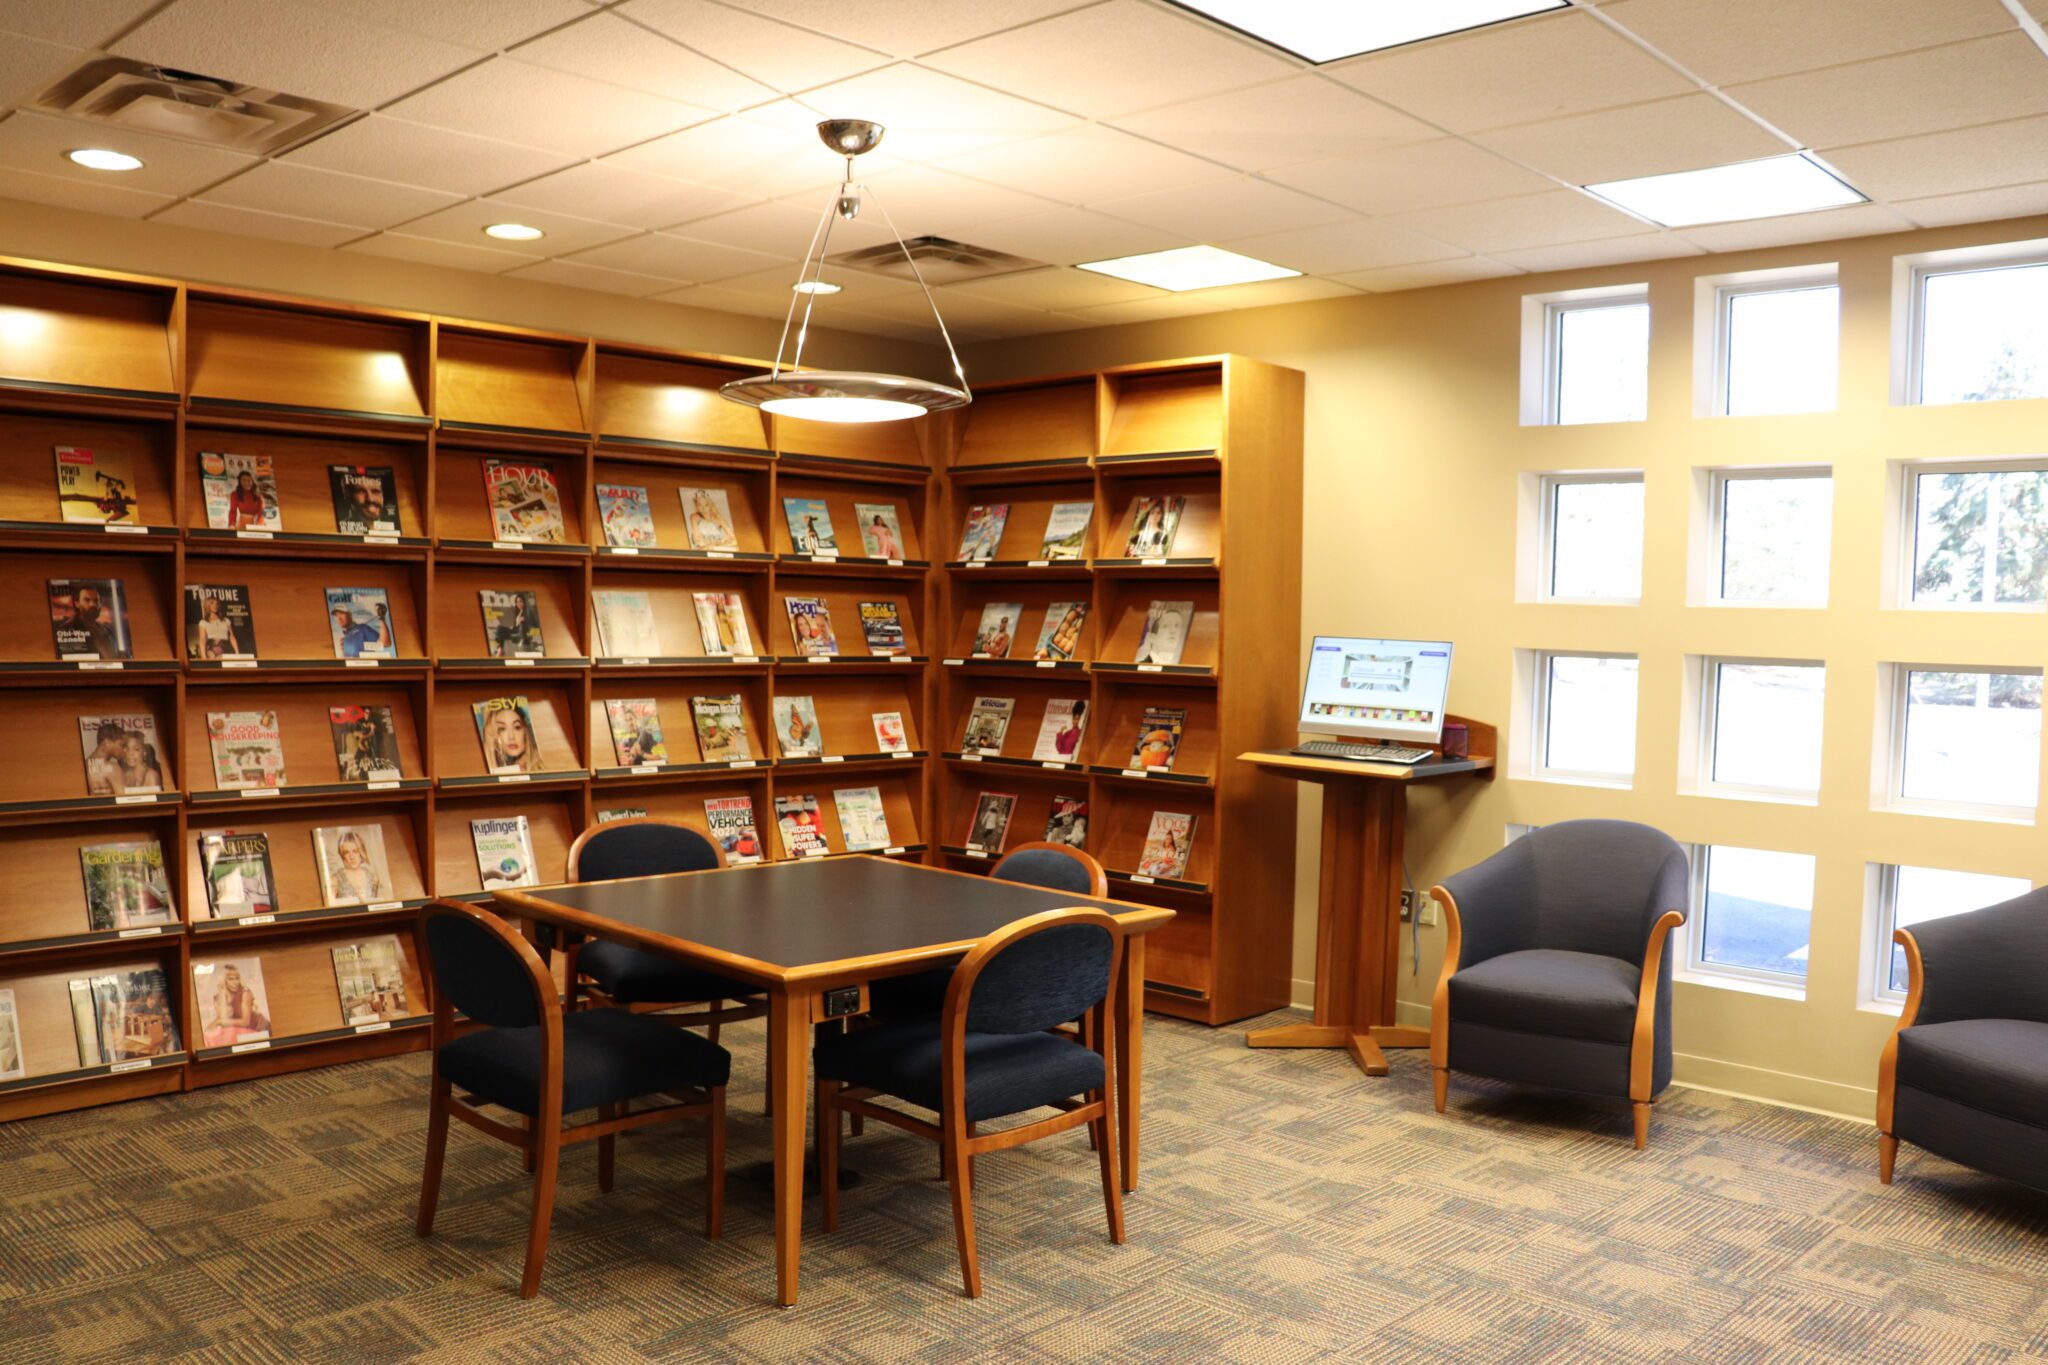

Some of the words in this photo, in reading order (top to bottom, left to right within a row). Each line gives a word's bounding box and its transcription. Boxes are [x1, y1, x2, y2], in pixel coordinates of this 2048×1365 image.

[60, 465, 80, 476] POWER
[62, 475, 75, 486] PLAY
[344, 474, 382, 488] Forbes
[192, 588, 239, 601] FORTUNE
[230, 723, 260, 735] GOOD
[209, 731, 280, 740] HOUSEKEEPING
[709, 816, 755, 829] VEHICLE
